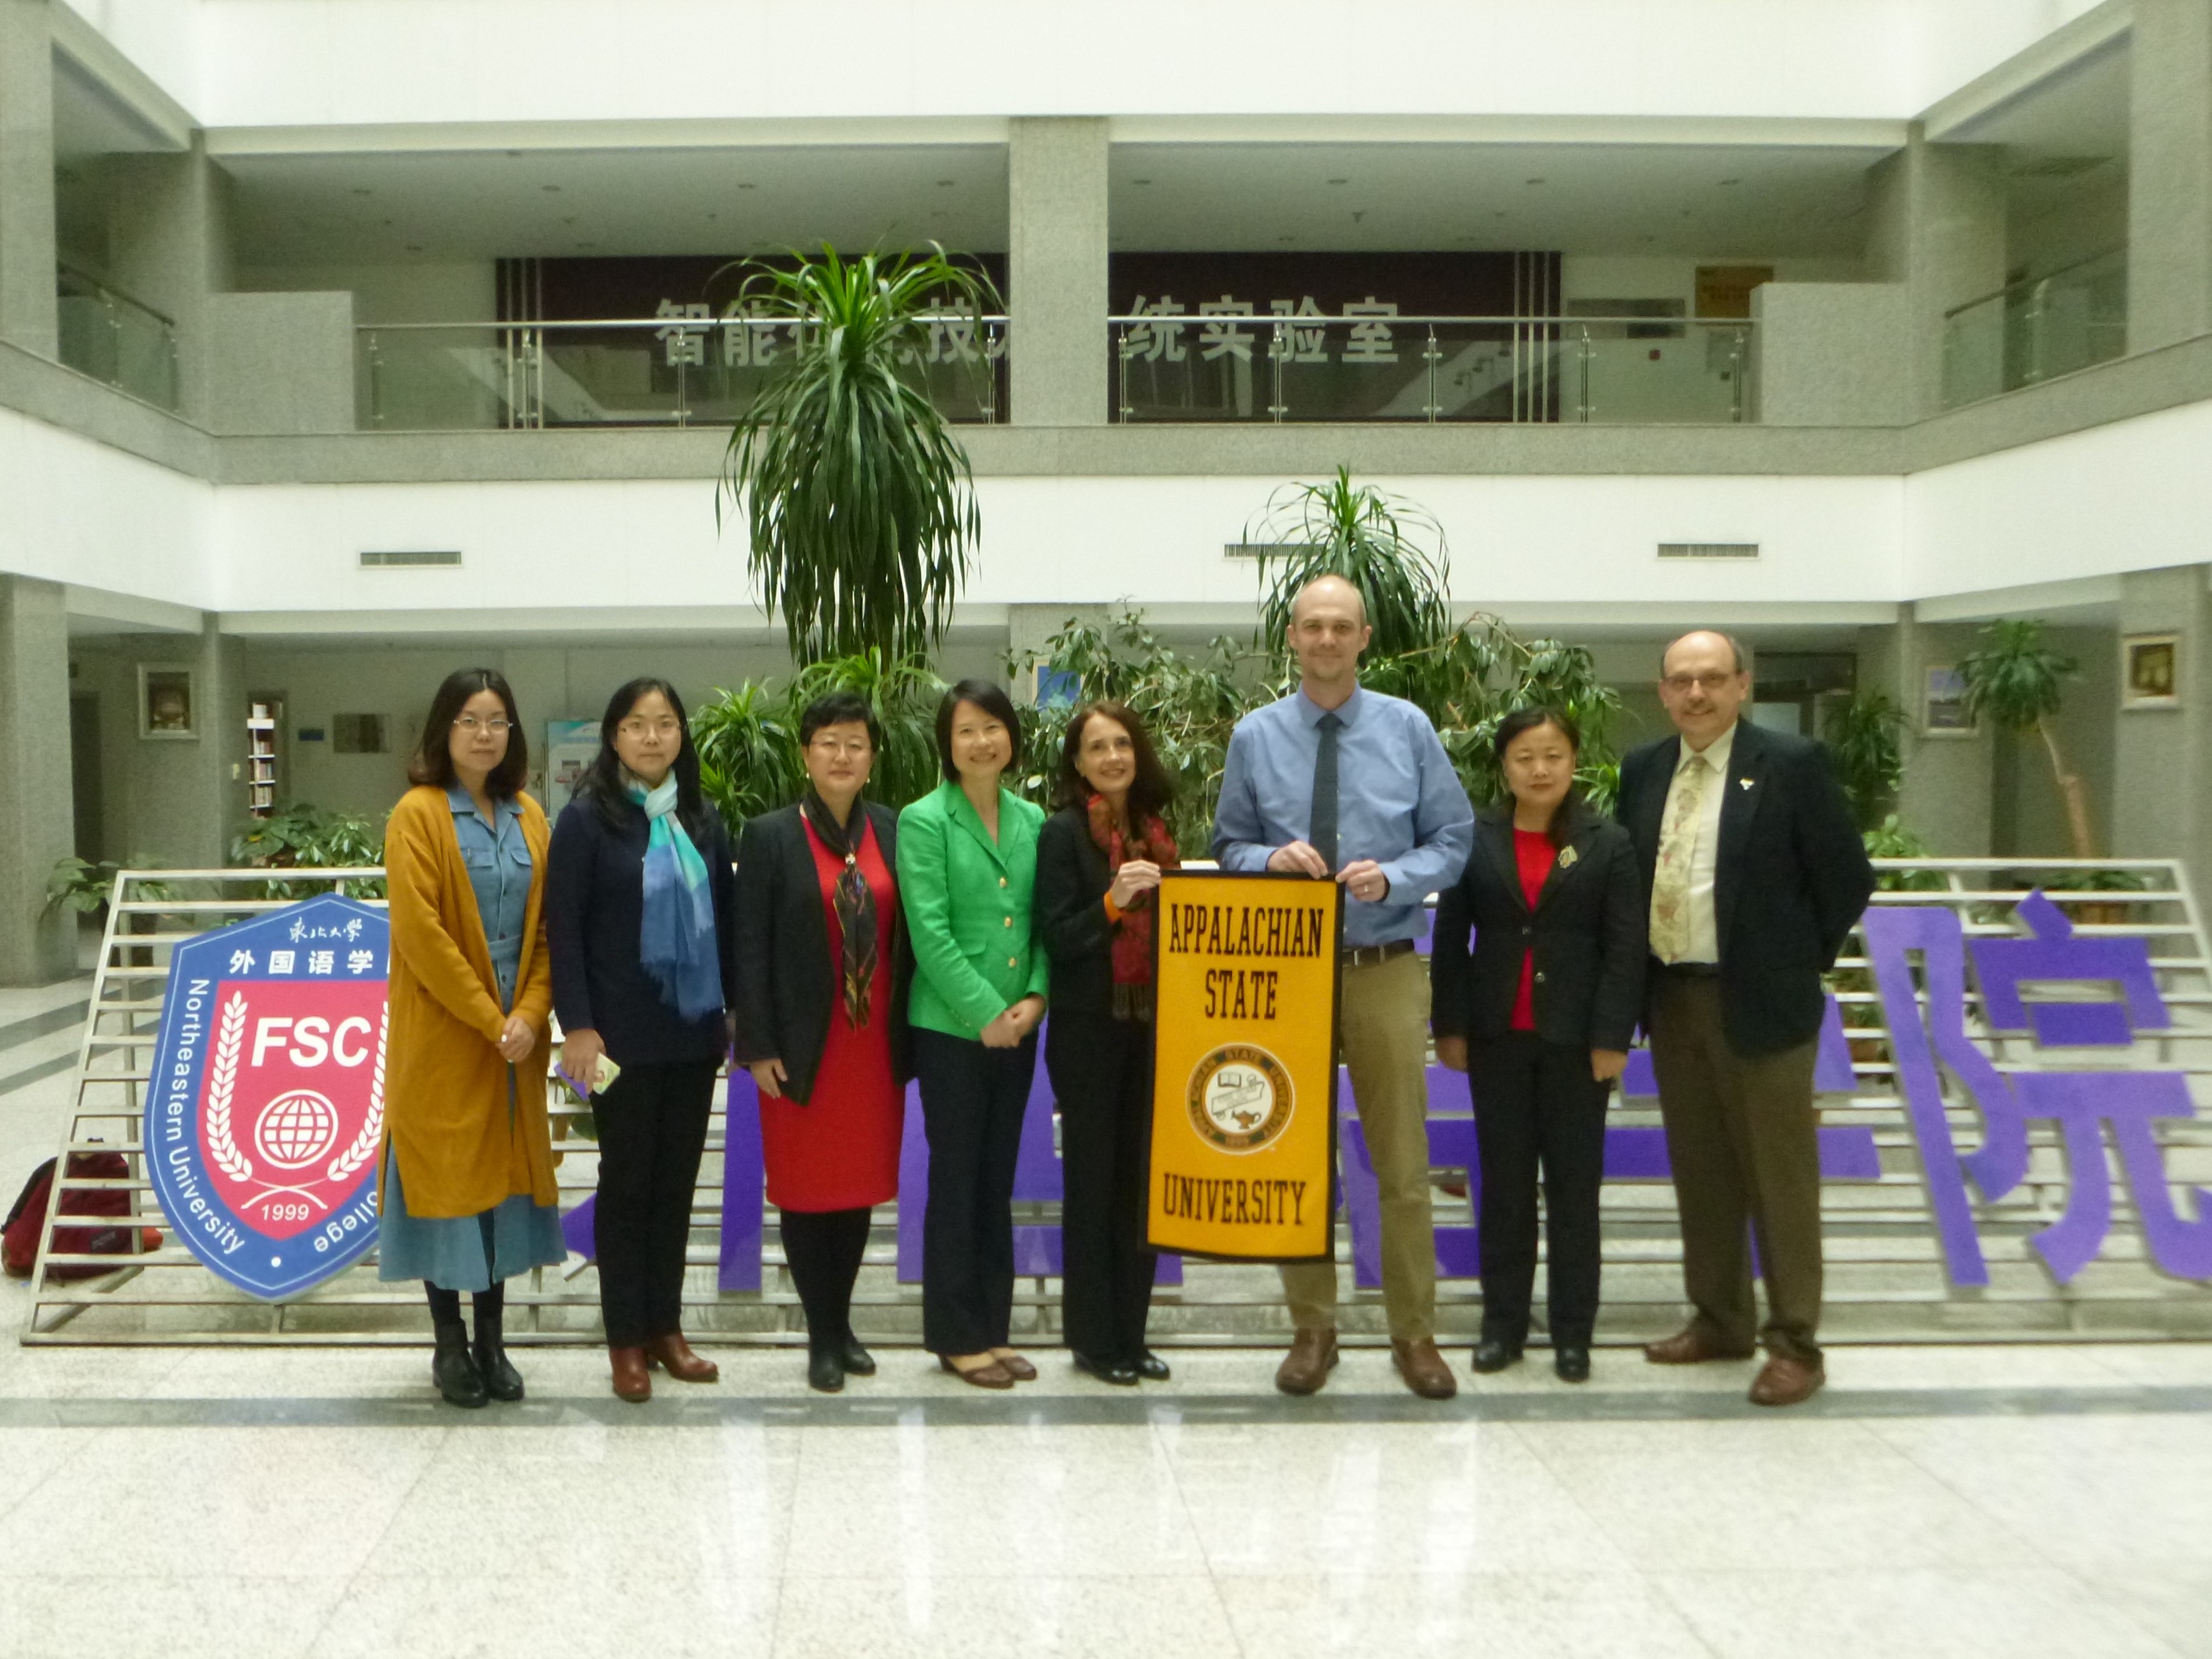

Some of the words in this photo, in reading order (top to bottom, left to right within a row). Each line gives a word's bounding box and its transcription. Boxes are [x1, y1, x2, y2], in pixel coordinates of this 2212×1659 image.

[1127, 294, 1398, 363] 统实验室
[1169, 903, 1324, 958] APPALACHIAN
[229, 949, 390, 974] 外国语学
[1205, 968, 1278, 1020] STATE
[166, 979, 210, 1142] Northeastern
[251, 1016, 372, 1068] FSC
[169, 1146, 245, 1255] University
[262, 1203, 310, 1221] 1999
[314, 1191, 378, 1252] ollege
[1164, 1173, 1307, 1225] UNIVERSITY
